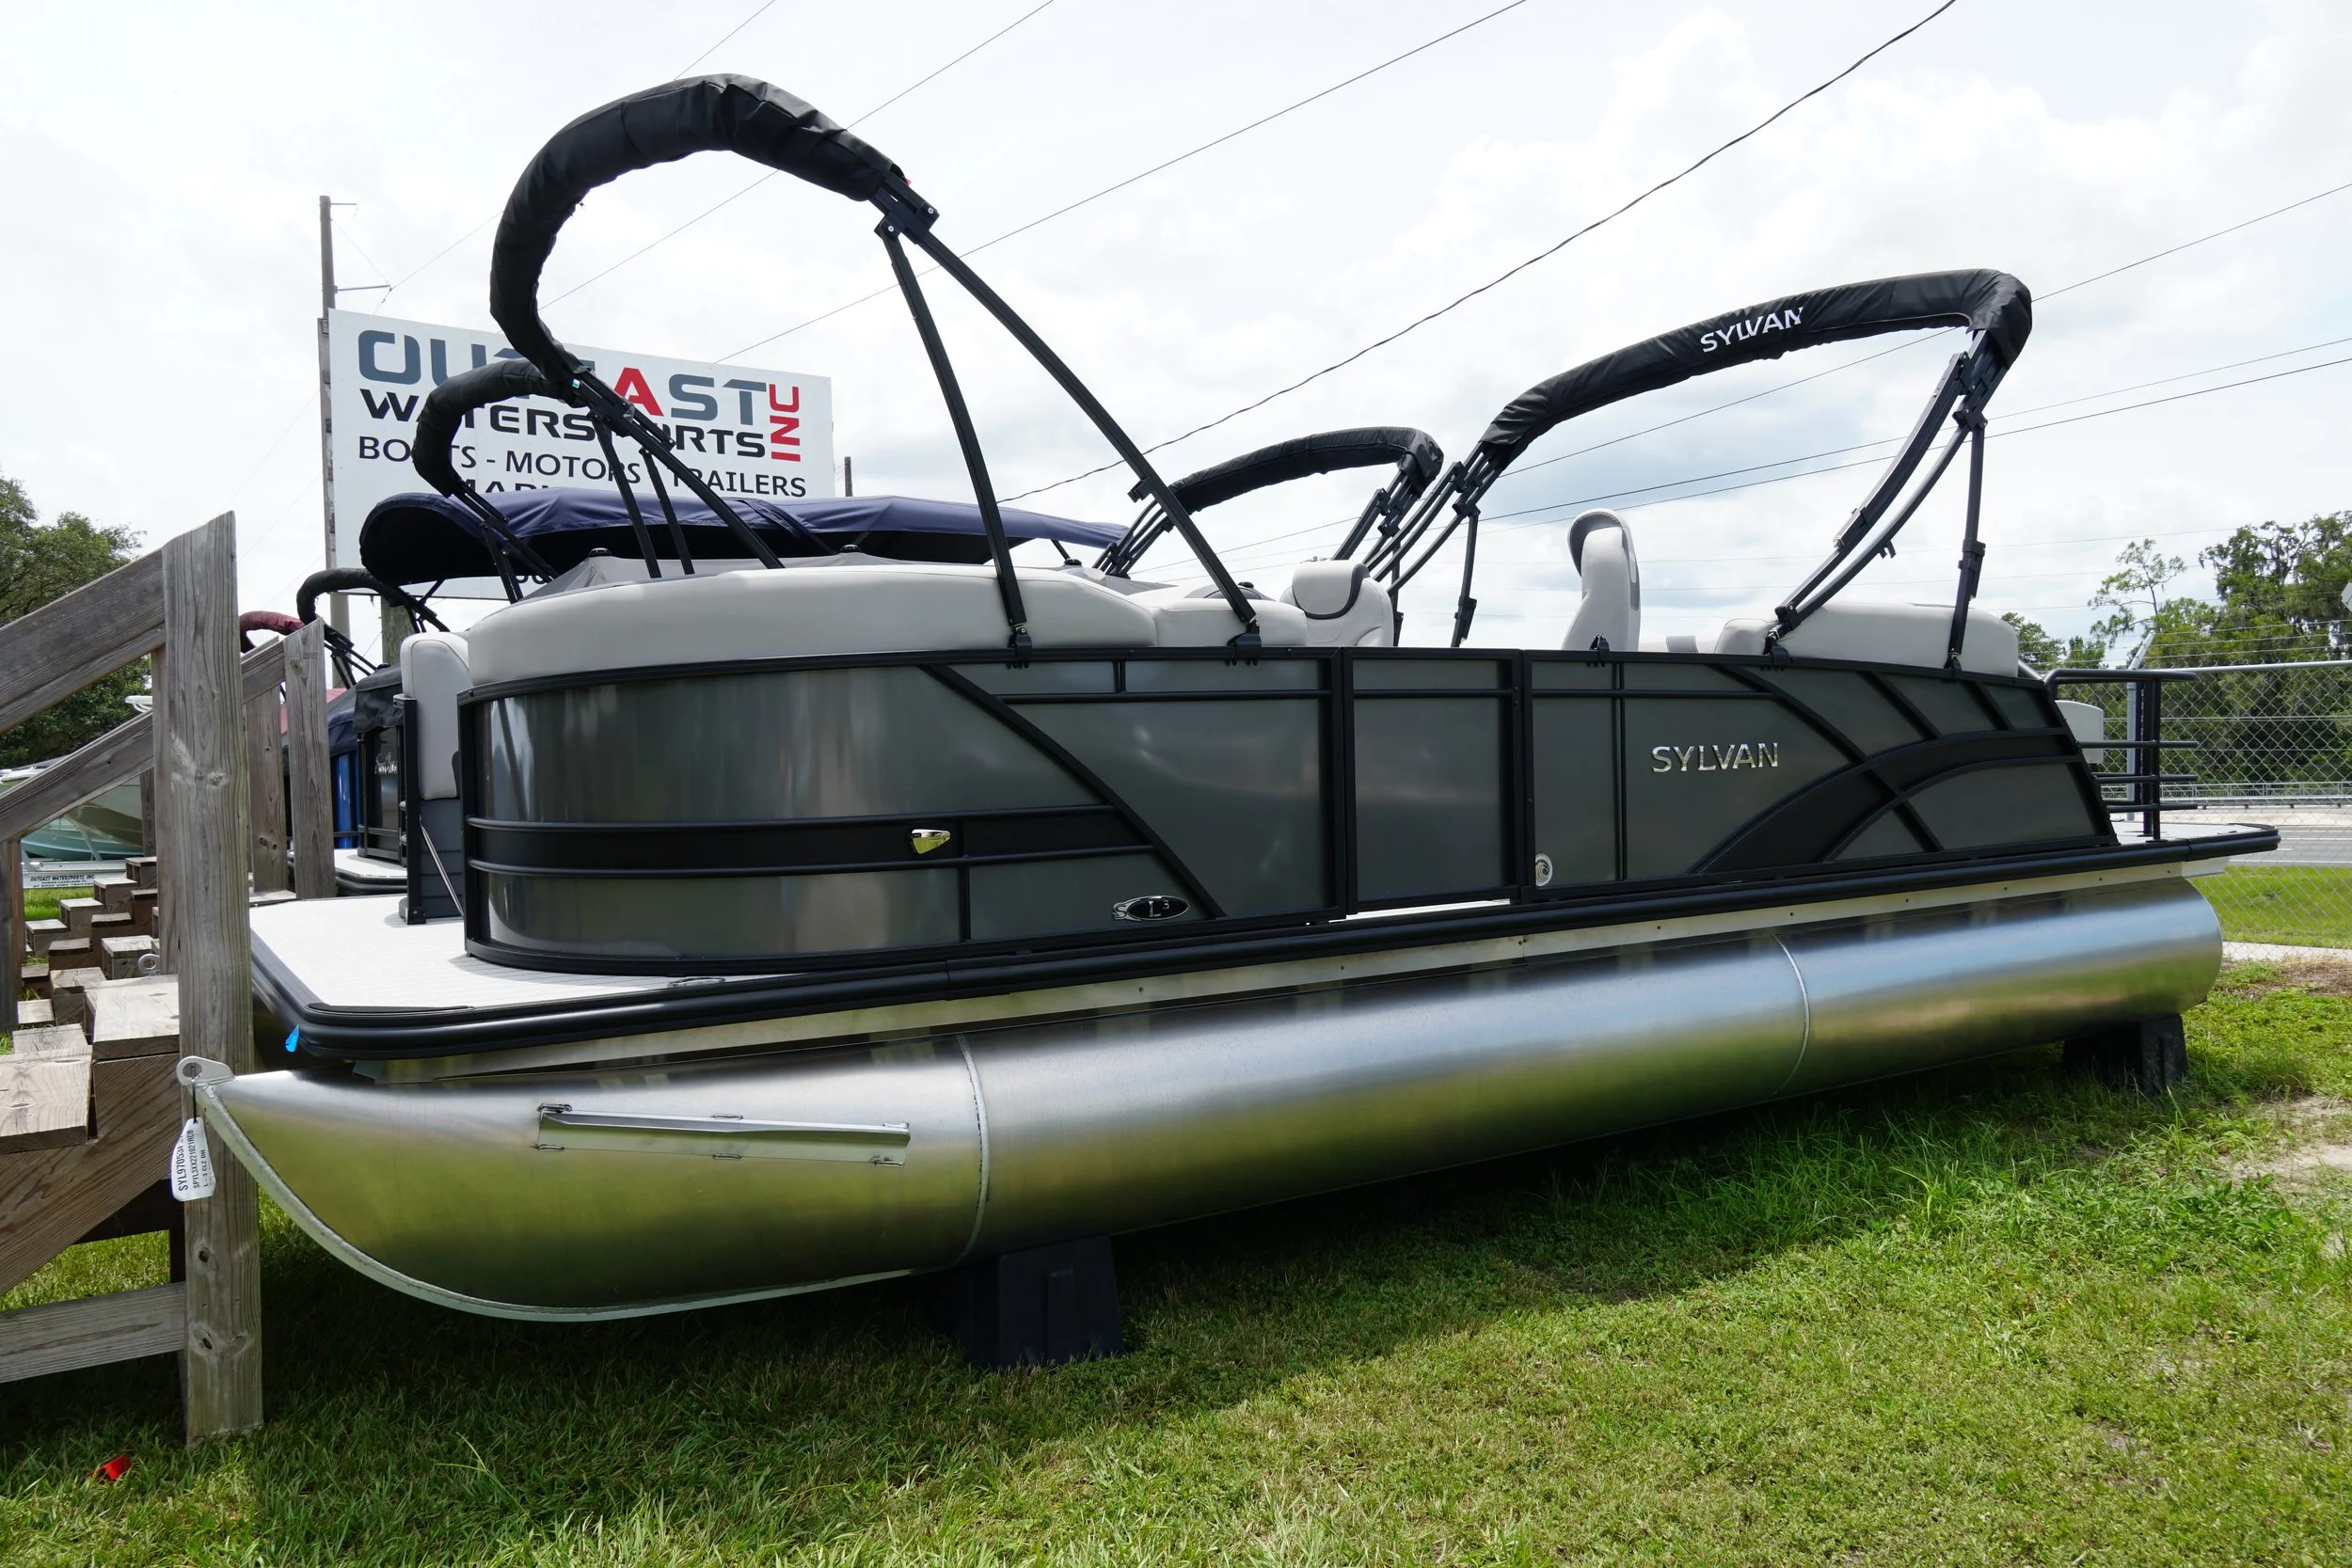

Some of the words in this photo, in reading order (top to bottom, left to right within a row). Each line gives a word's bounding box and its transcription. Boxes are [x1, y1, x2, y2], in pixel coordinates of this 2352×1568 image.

[1700, 307, 1804, 353] SYLVAN
[769, 384, 801, 462] INC
[1651, 742, 1778, 773] SYLVAN
